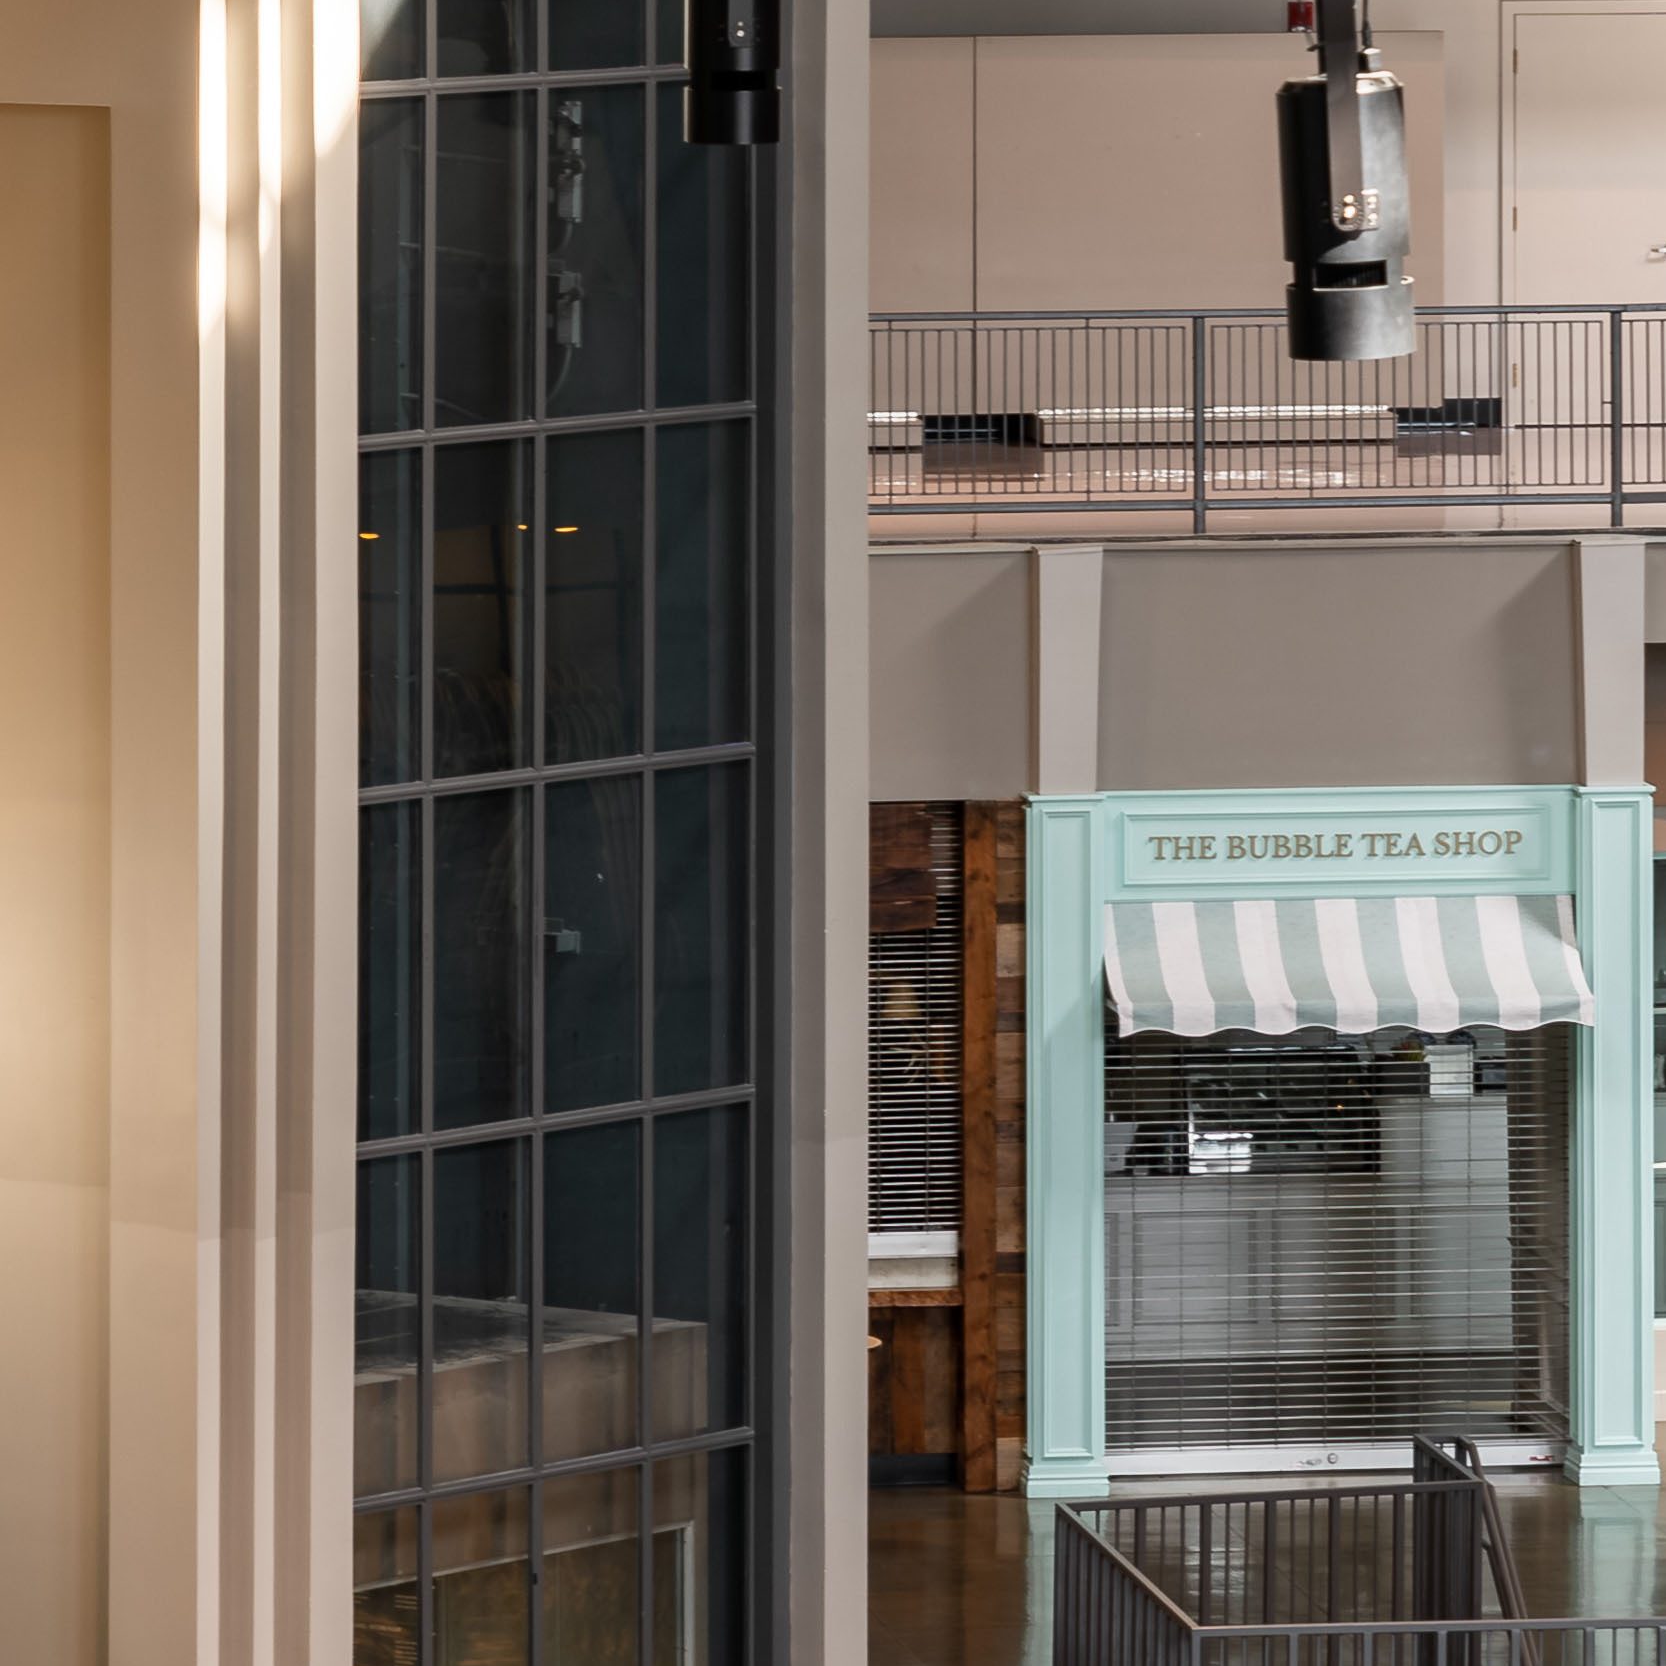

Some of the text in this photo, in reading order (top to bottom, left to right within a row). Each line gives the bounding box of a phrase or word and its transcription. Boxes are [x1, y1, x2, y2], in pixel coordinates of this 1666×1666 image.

[1148, 830, 1523, 861] THE BUBBLE TEA SHOP
